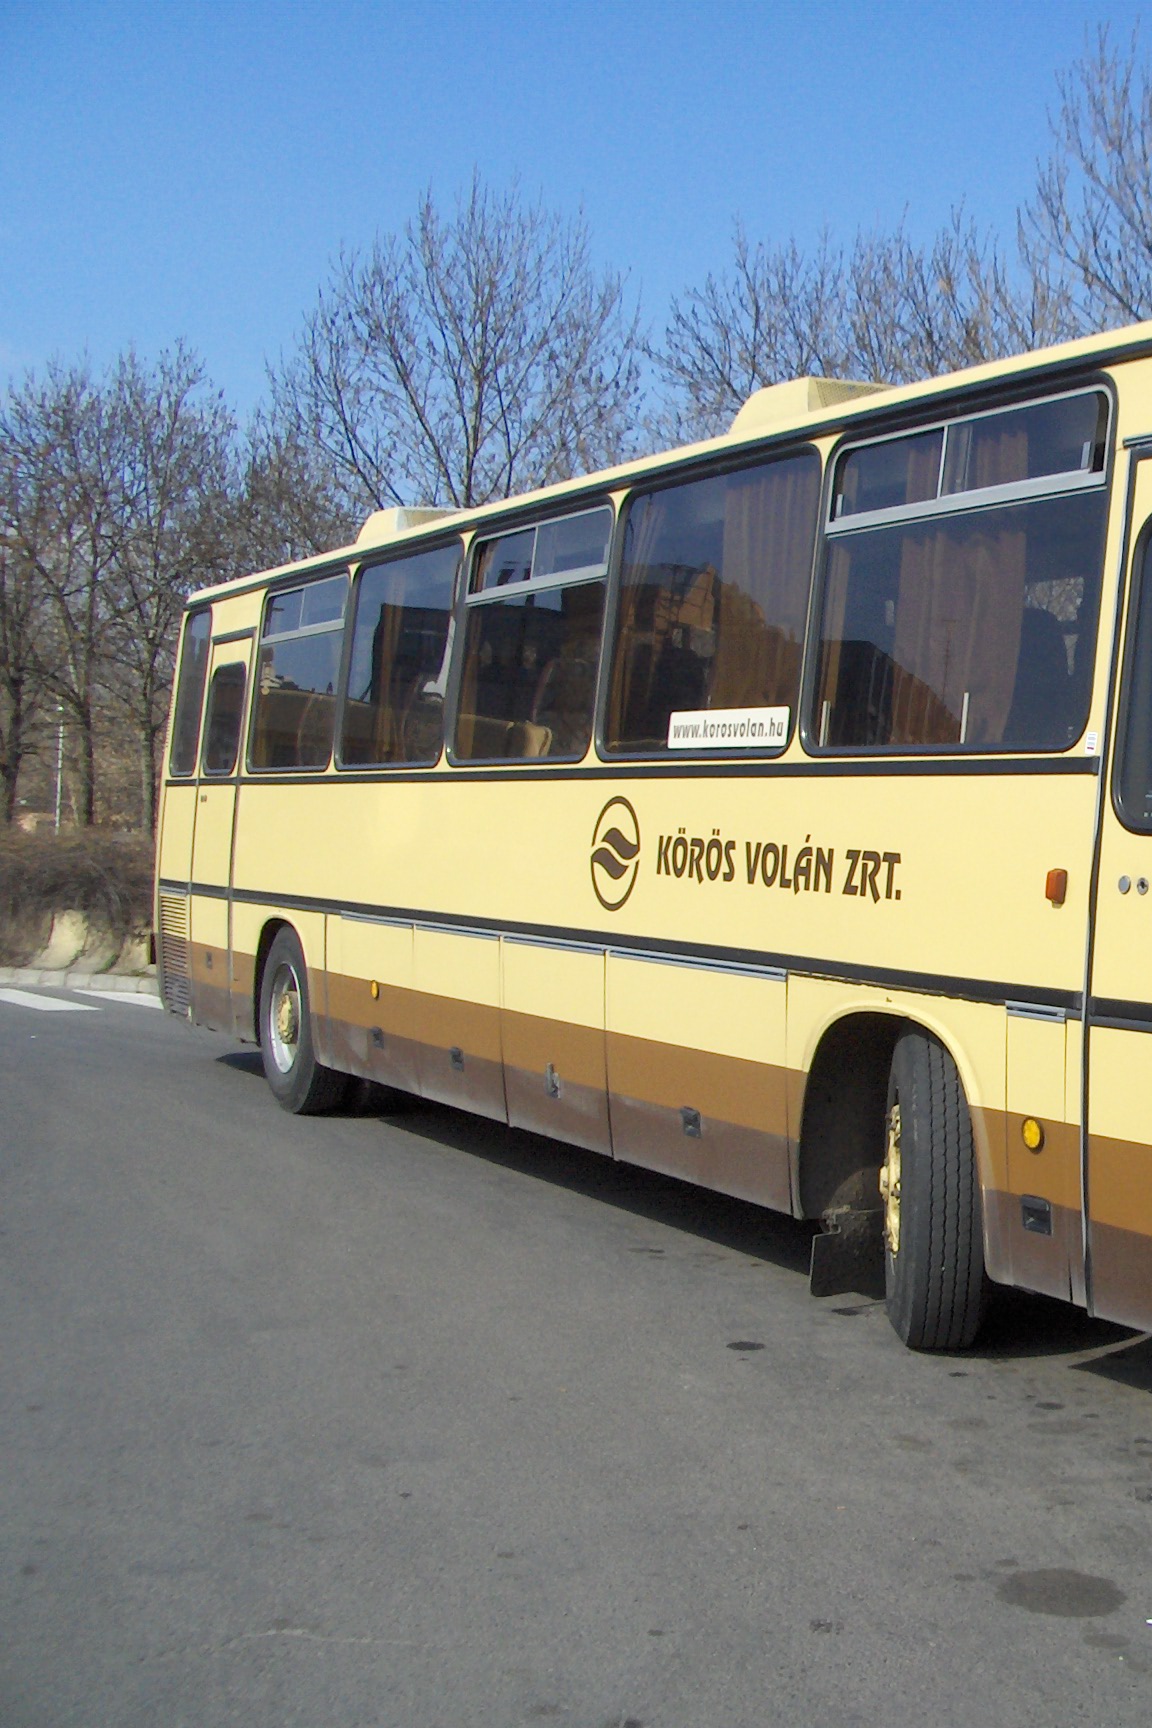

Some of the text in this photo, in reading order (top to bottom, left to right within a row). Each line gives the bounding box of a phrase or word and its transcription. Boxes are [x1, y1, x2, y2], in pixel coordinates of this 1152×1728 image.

[673, 718, 784, 739] www.korosvolan.hu
[656, 827, 902, 904] KÖRÖS VOLÁN ZRT.
